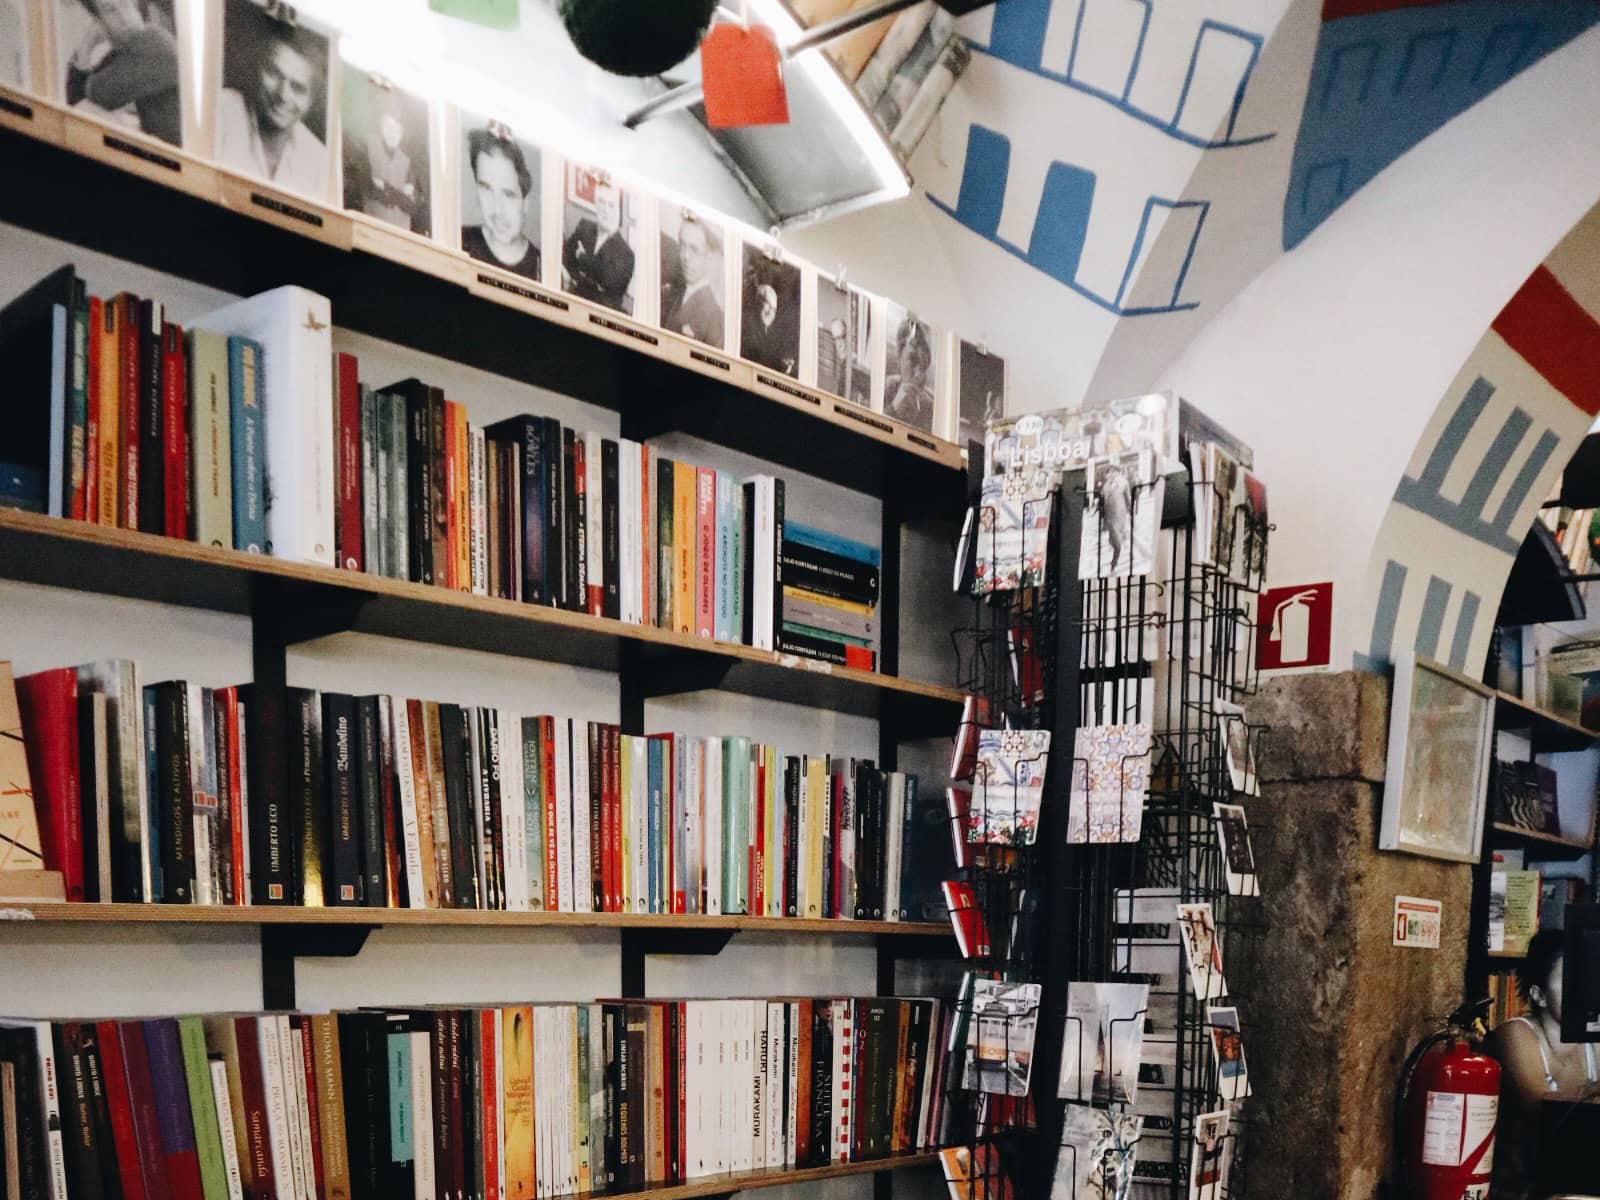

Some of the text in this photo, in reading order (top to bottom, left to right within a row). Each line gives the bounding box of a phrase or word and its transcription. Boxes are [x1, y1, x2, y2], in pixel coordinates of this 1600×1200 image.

[246, 426, 256, 454] Ponte
[526, 423, 537, 476] BOWLES
[1010, 440, 1084, 468] Lisboa
[248, 492, 257, 521] Drina
[578, 562, 586, 606] DEMANDA
[336, 717, 348, 772] Baudolino
[491, 727, 500, 781] DARIO FO
[528, 740, 537, 783] JOSTEIN
[482, 778, 491, 822] LIVRARIA
[268, 803, 280, 873] UMBERTO ECO
[322, 1020, 332, 1065] THOMAS
[760, 1030, 768, 1073] HARUKI
[72, 1055, 82, 1077] DAVID
[75, 1077, 86, 1099] LODGE
[325, 1067, 335, 1101] MANN
[753, 1075, 761, 1137] MURAKAMI
[815, 1060, 825, 1138] FRANCESA
[251, 1110, 268, 1178] Samarcanda
